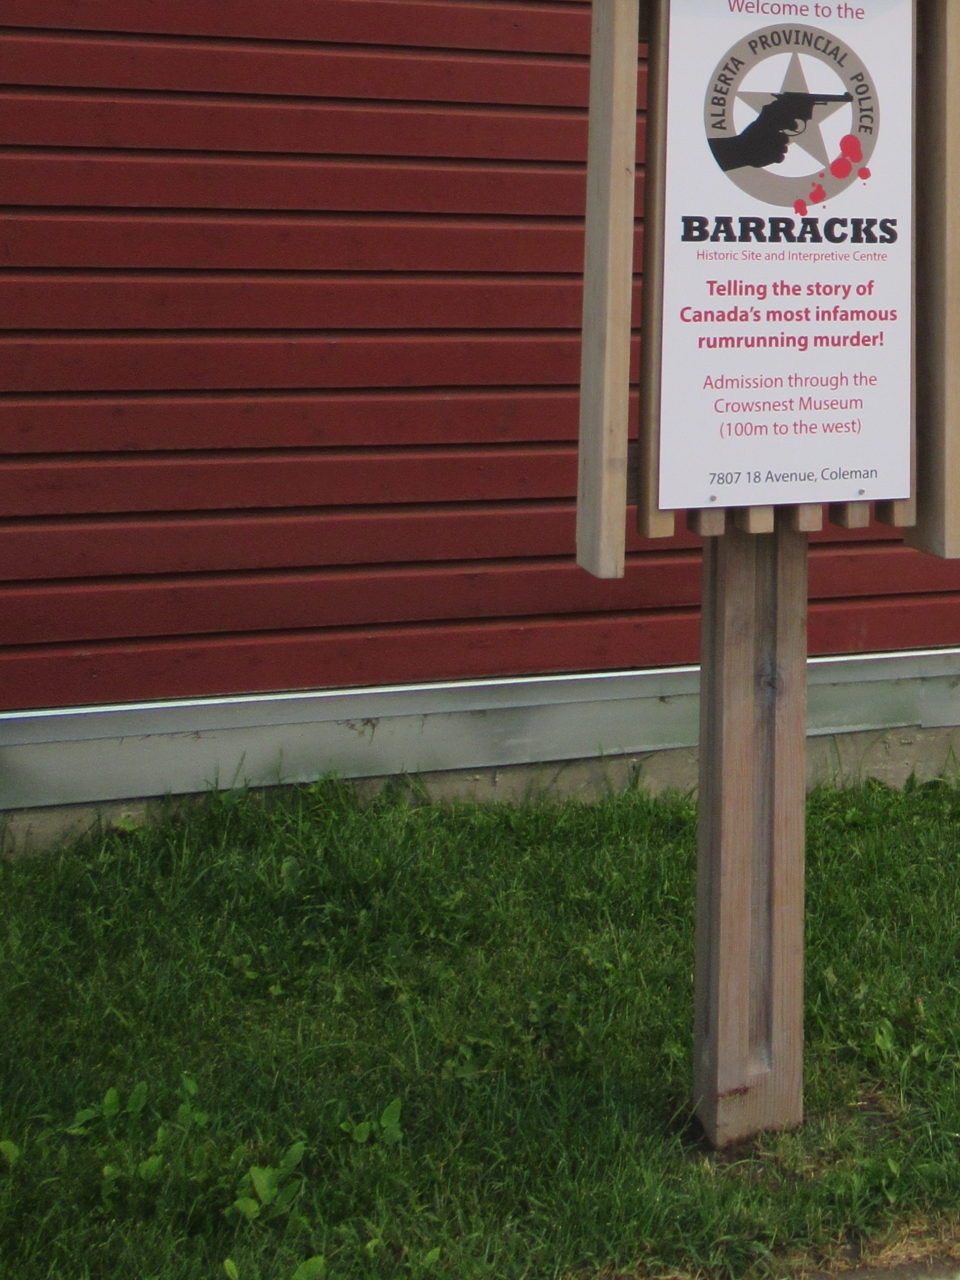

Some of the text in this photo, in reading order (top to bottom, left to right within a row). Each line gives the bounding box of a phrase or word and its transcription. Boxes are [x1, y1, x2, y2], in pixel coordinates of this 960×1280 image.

[815, 3, 832, 18] to
[837, 2, 865, 20] the
[711, 29, 875, 136] ALBERTA PROVINCIAL POLICE
[681, 215, 898, 244] BARRACKS
[696, 249, 888, 263] Historic Site and Interpretive Centre
[706, 280, 875, 300] Telling the story of
[680, 306, 898, 323] Canada’s most infamous
[698, 331, 884, 351] rumrunning murder!
[703, 372, 877, 390] Admission through the
[714, 396, 863, 414] Crowsnest Museum
[719, 419, 862, 439] (100m to the west)
[708, 467, 878, 485] 7807 18 Avenue, Coleman
